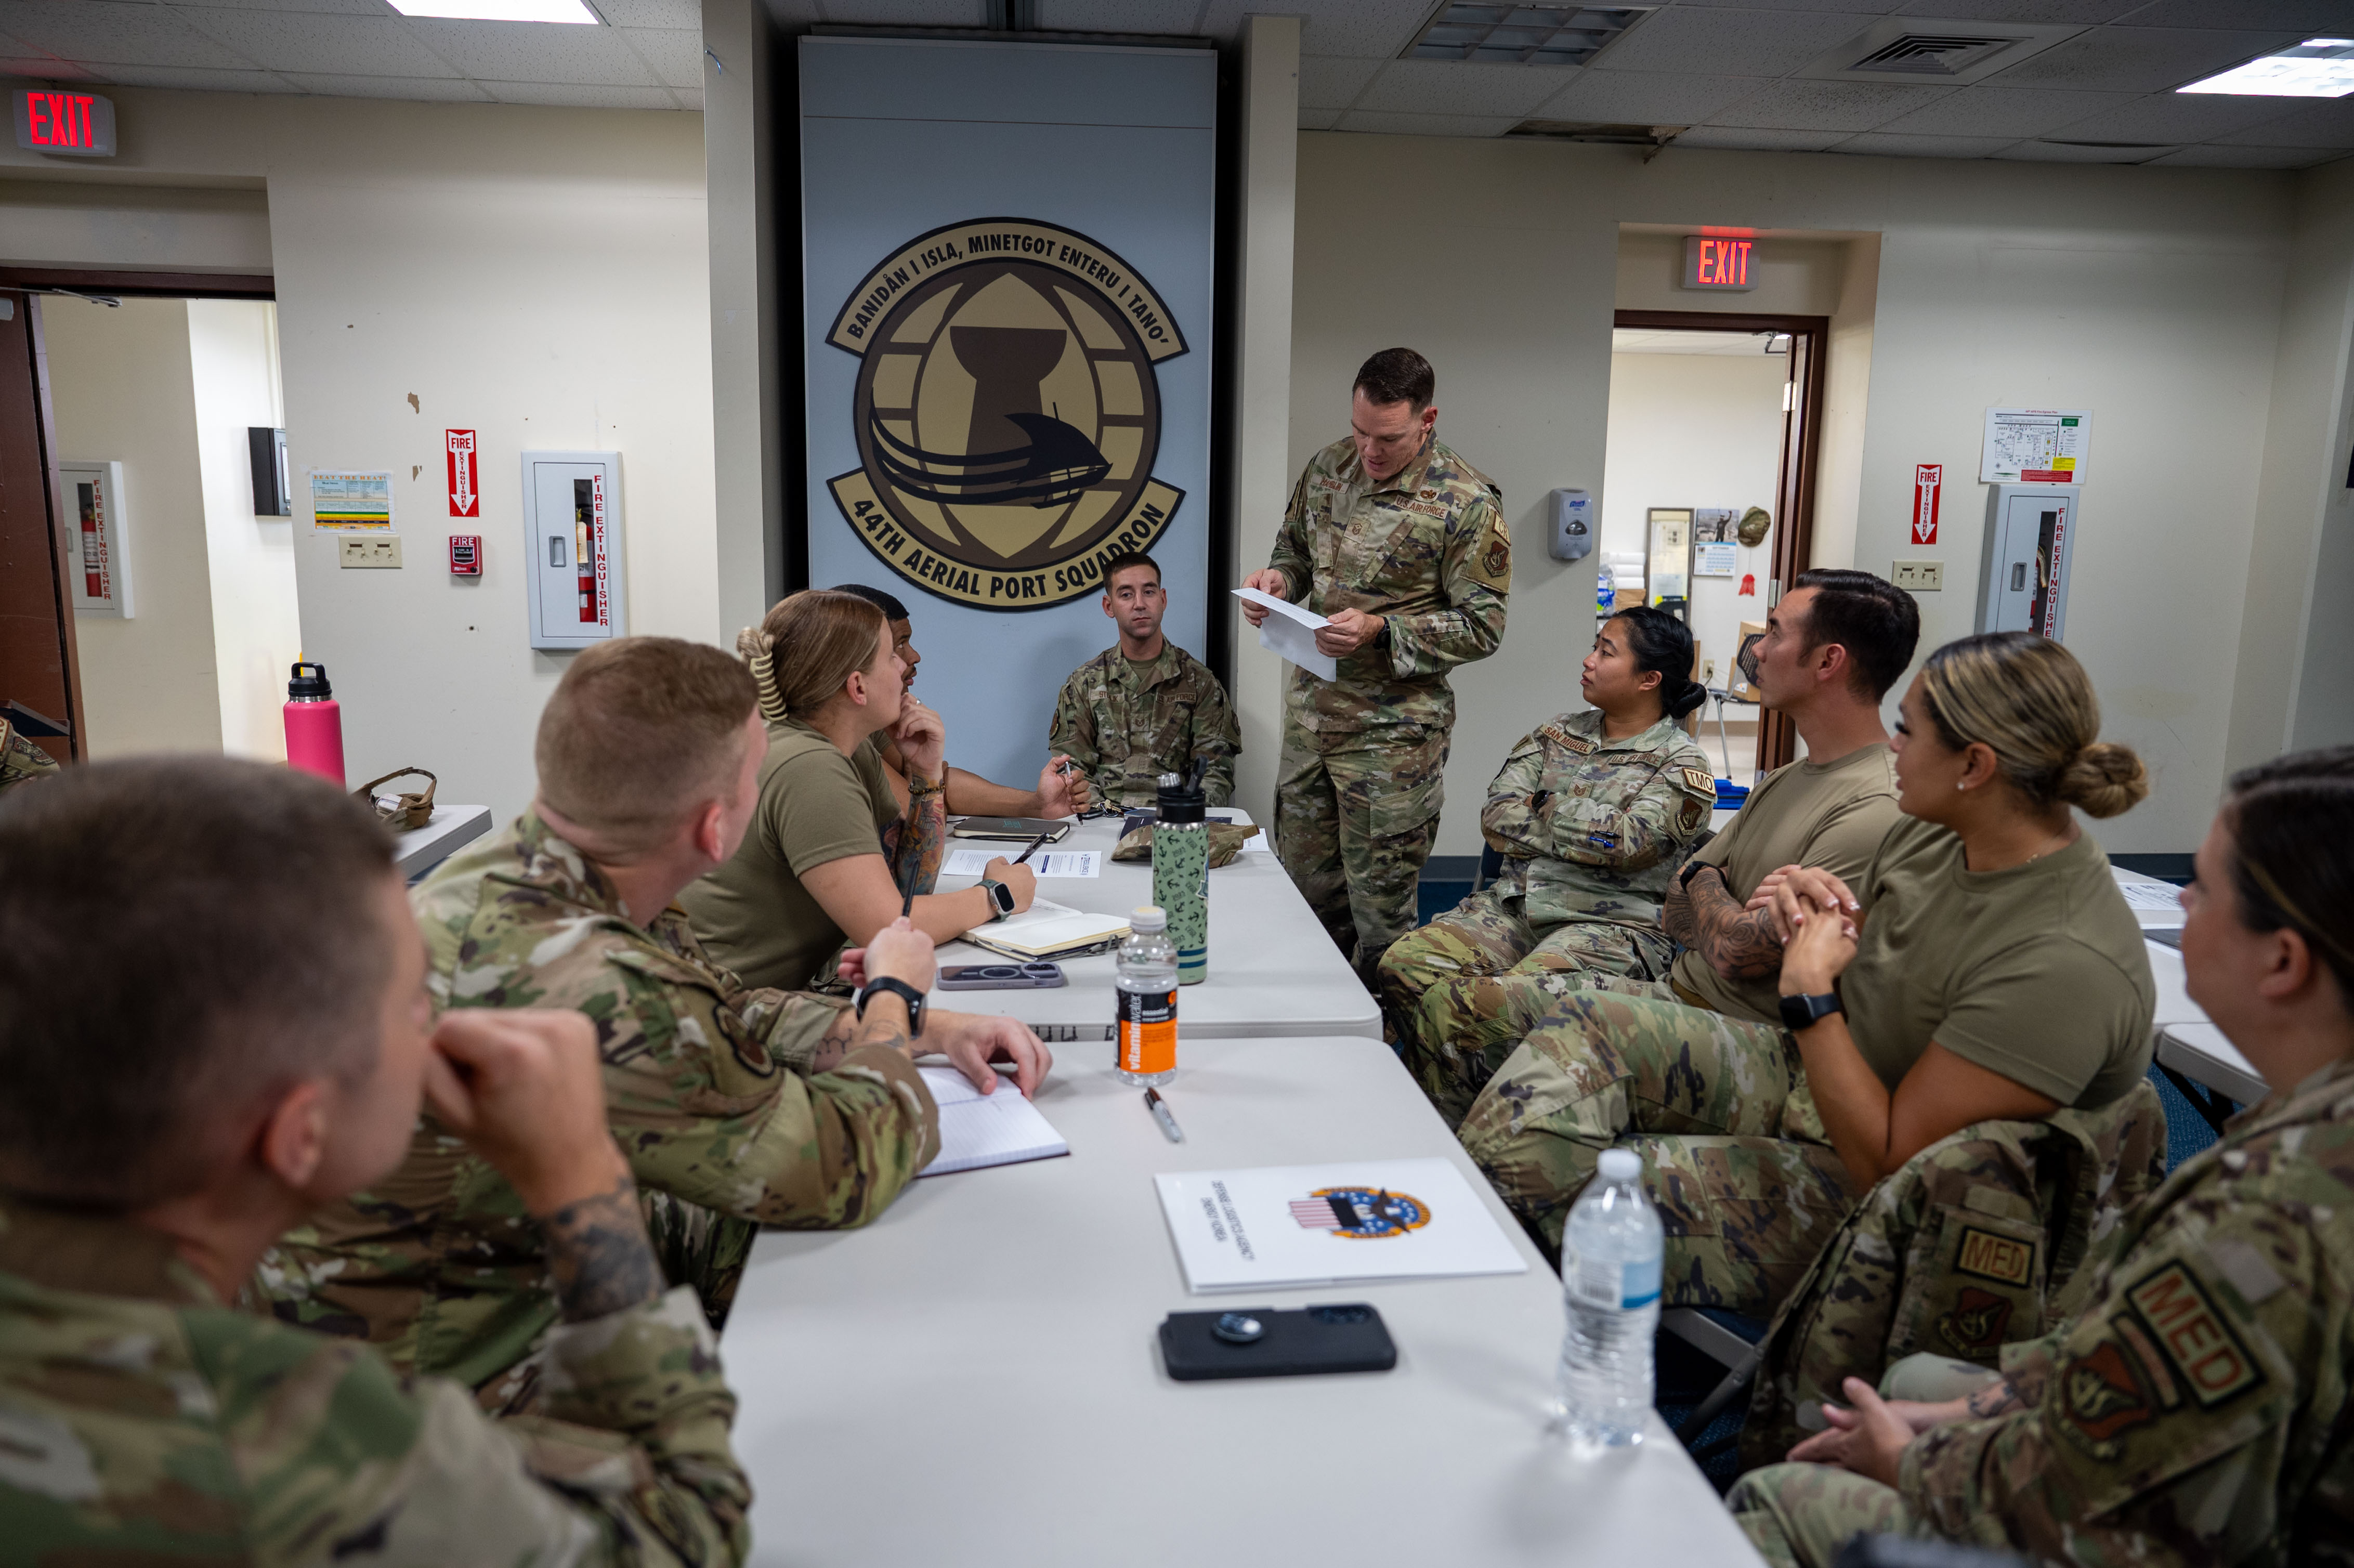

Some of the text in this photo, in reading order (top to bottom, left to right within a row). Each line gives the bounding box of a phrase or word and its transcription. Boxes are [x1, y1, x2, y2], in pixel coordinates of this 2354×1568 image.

[27, 92, 94, 148] EXIT
[909, 259, 921, 275] I
[920, 242, 963, 269] ISLA,
[968, 234, 1056, 257] MINETGOT
[1058, 245, 1121, 288] ENTERU
[1118, 284, 1131, 298] I
[1698, 240, 1753, 285] EXIT
[451, 438, 471, 449] FIRE
[1920, 472, 1937, 482] FIRE
[1396, 497, 1446, 517] U.S. AIR FORCE
[1922, 485, 1930, 537] EXTINGUISHER
[94, 479, 111, 599] FIRE EXTINGUISHER
[452, 537, 475, 545] FIRE
[594, 475, 608, 626] FIRE EXTINGUISHER
[854, 500, 1165, 599] 44TH AERIAL PORT SQUADRON
[2045, 508, 2065, 639] FIRE EXTINGUISHE
[1545, 726, 1589, 752] SAN MIGUEL
[1688, 771, 1712, 791] TMO
[1965, 1234, 2025, 1279] MED
[2140, 1273, 2242, 1392] MED
